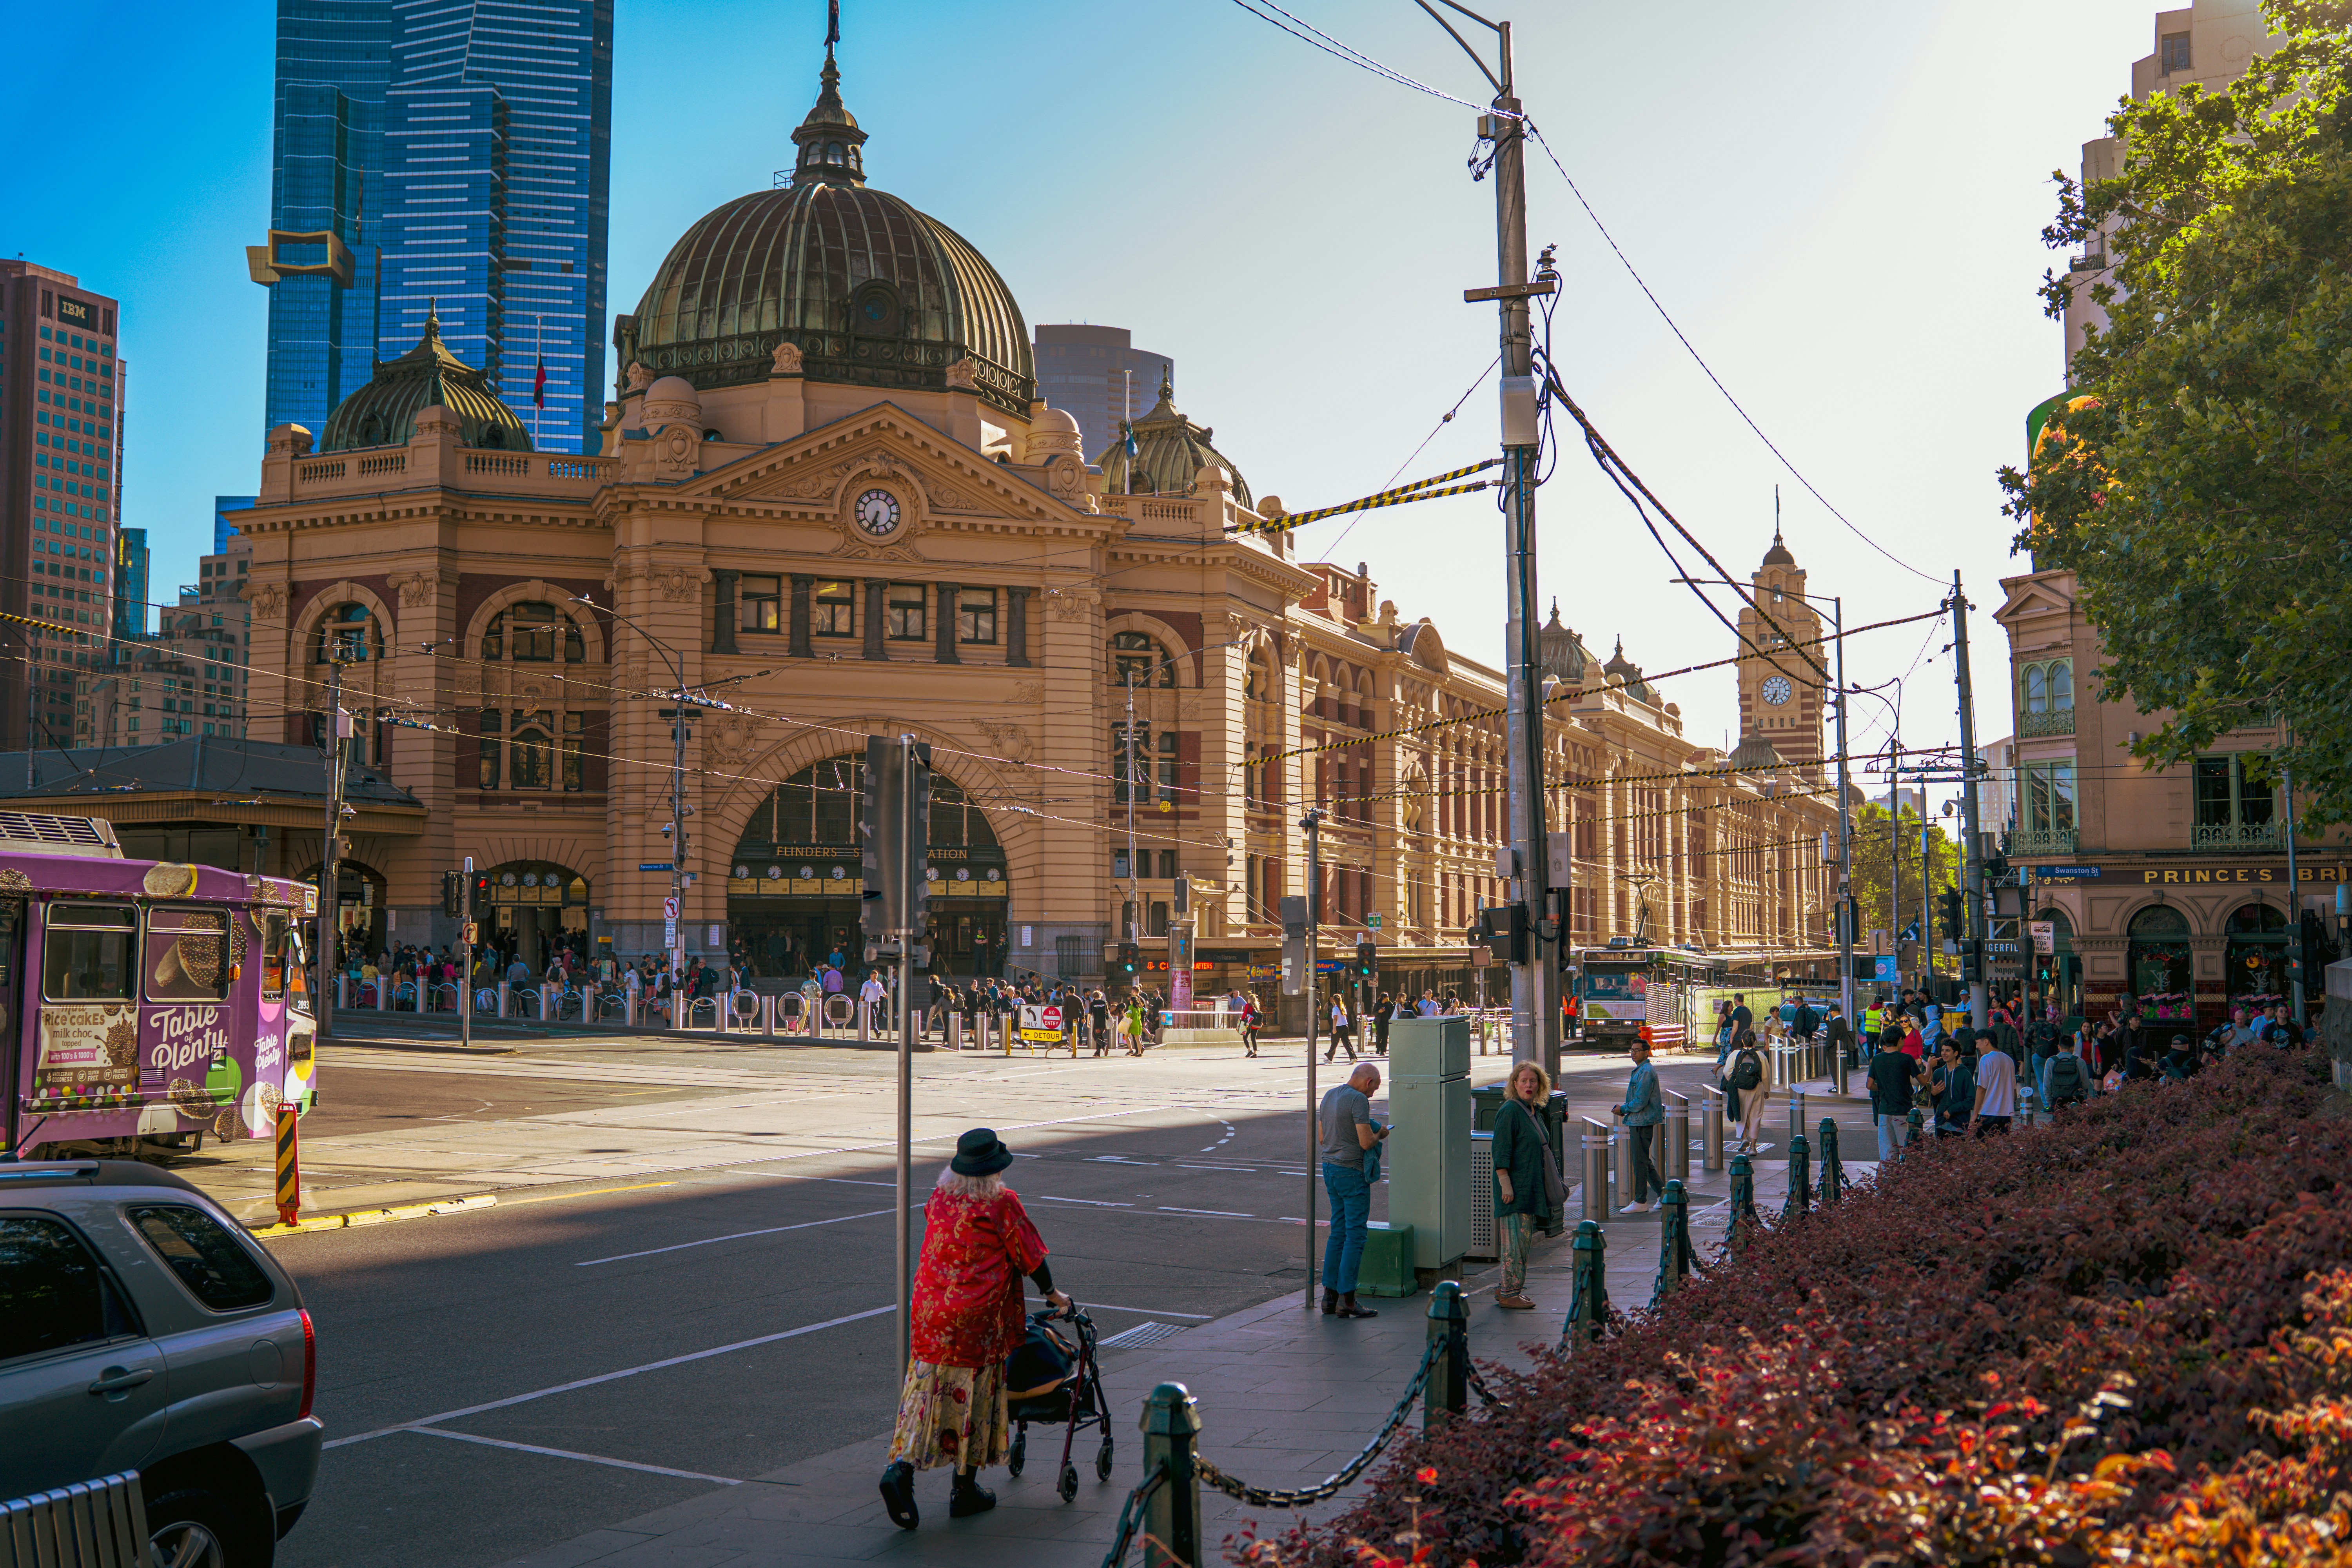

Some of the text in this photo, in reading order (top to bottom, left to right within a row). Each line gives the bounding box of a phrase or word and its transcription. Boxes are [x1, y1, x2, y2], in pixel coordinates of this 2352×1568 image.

[62, 301, 85, 319] IBM
[777, 846, 837, 857] FLINDERS
[927, 849, 967, 858] ATION
[2145, 869, 2273, 883] PRINCE'S
[1256, 967, 1274, 979] EzyMart
[298, 1000, 309, 1009] 2093
[45, 1011, 67, 1026] Rice
[150, 1004, 219, 1042] Table
[53, 1028, 92, 1038] milk choc
[184, 1032, 194, 1044] of
[62, 1040, 82, 1048] topped
[151, 1028, 228, 1071] Plenty
[254, 1033, 278, 1055] Table
[255, 1047, 281, 1073] Plenty
